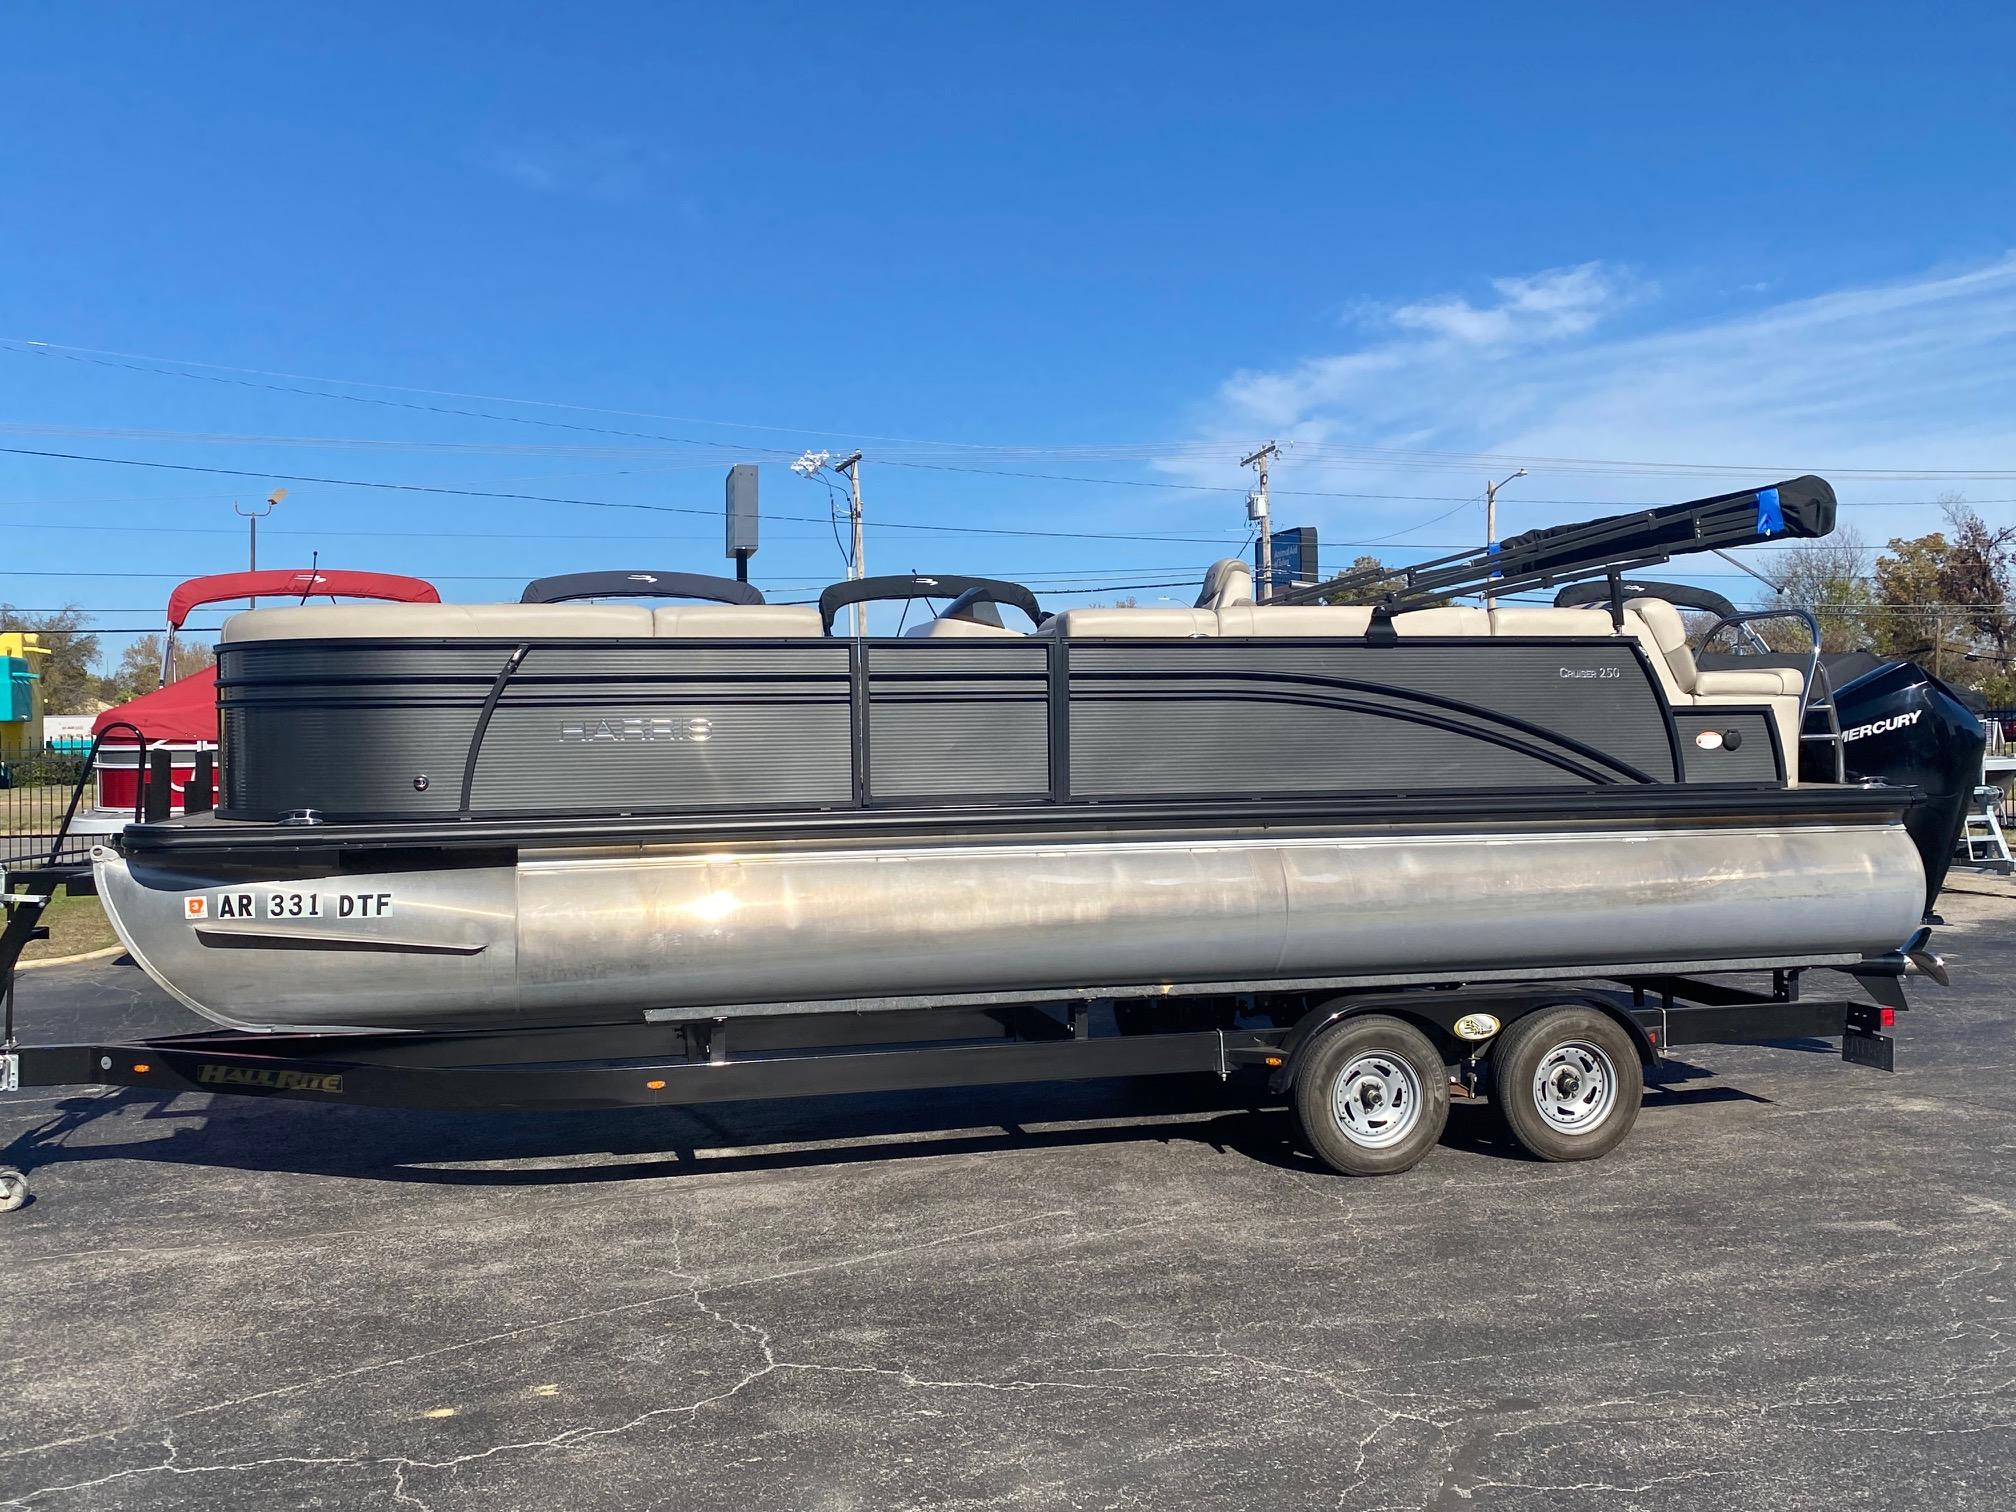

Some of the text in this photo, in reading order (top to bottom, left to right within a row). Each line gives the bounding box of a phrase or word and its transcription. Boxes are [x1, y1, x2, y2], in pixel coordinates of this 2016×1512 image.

[1599, 667, 1620, 678] 250
[559, 718, 713, 742] HARRIS
[219, 893, 391, 918] AR 331 DTF
